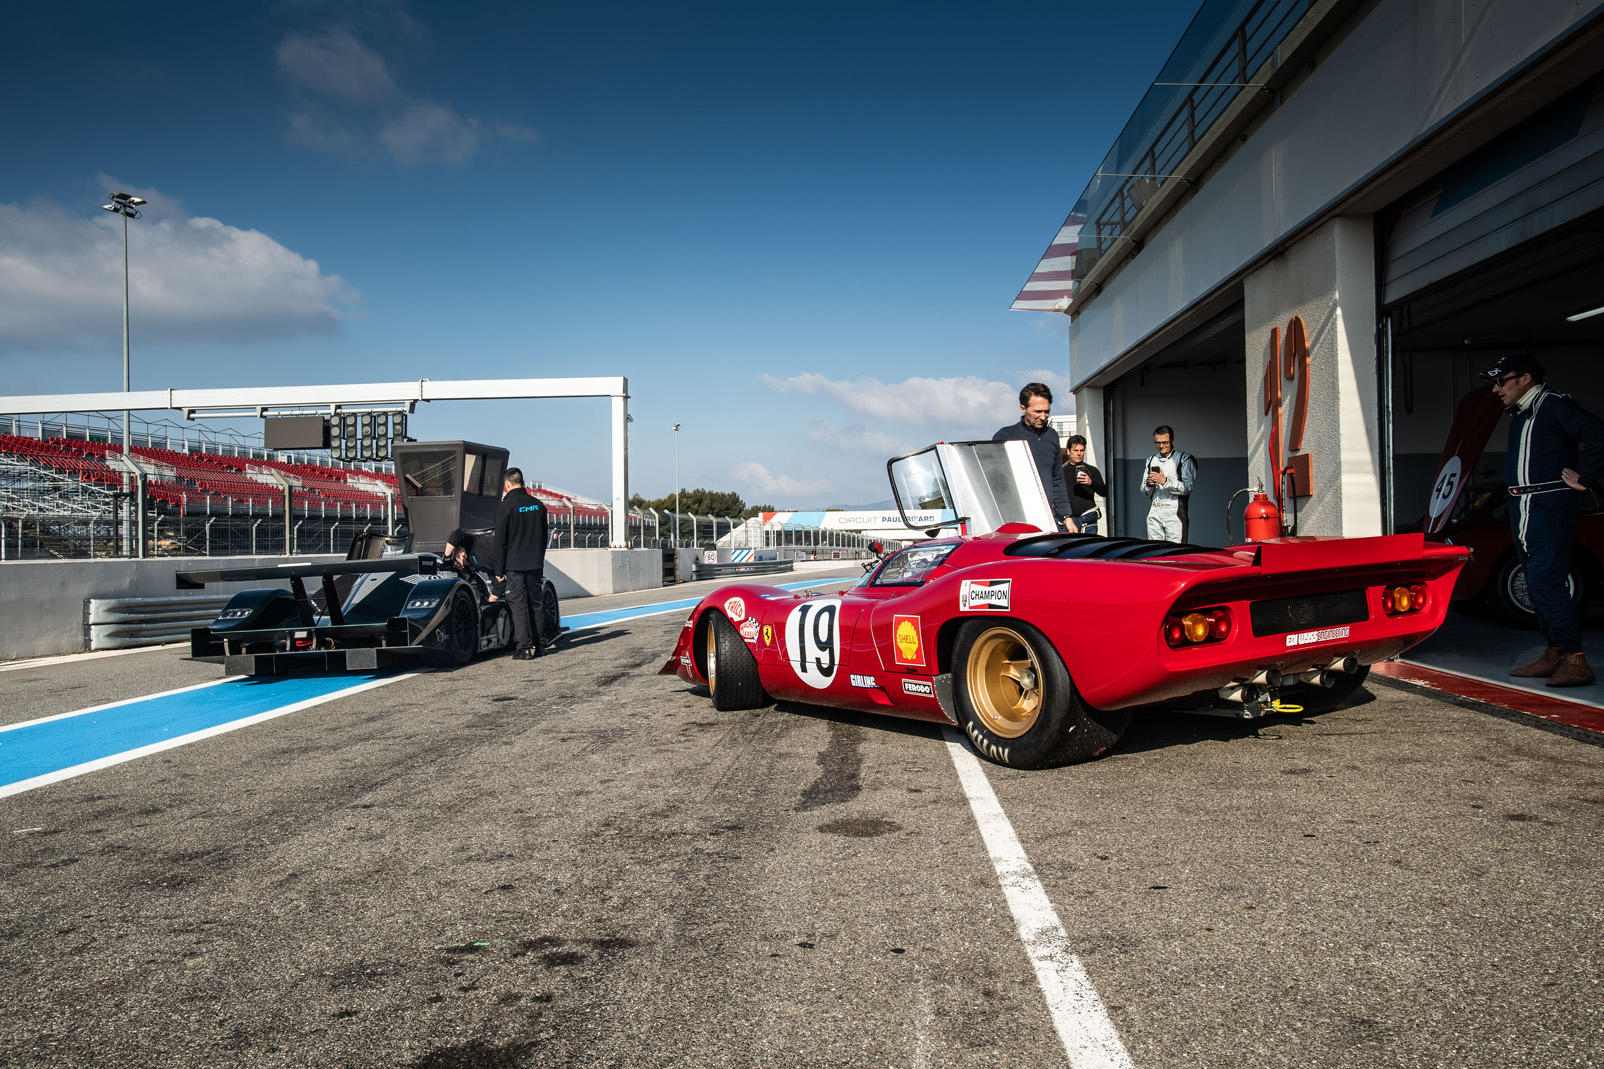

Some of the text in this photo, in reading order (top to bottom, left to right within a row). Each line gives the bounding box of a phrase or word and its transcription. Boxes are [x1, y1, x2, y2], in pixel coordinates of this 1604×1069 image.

[1264, 315, 1314, 500] 12
[1435, 473, 1457, 500] 45
[519, 505, 539, 513] CMR
[838, 516, 878, 524] CIRCUIT
[970, 590, 1008, 600] CHAMPION
[728, 599, 744, 618] TRICO
[798, 604, 837, 678] 19
[898, 635, 917, 645] SHELL
[850, 674, 877, 688] GIRLING
[905, 683, 930, 693] FERODO
